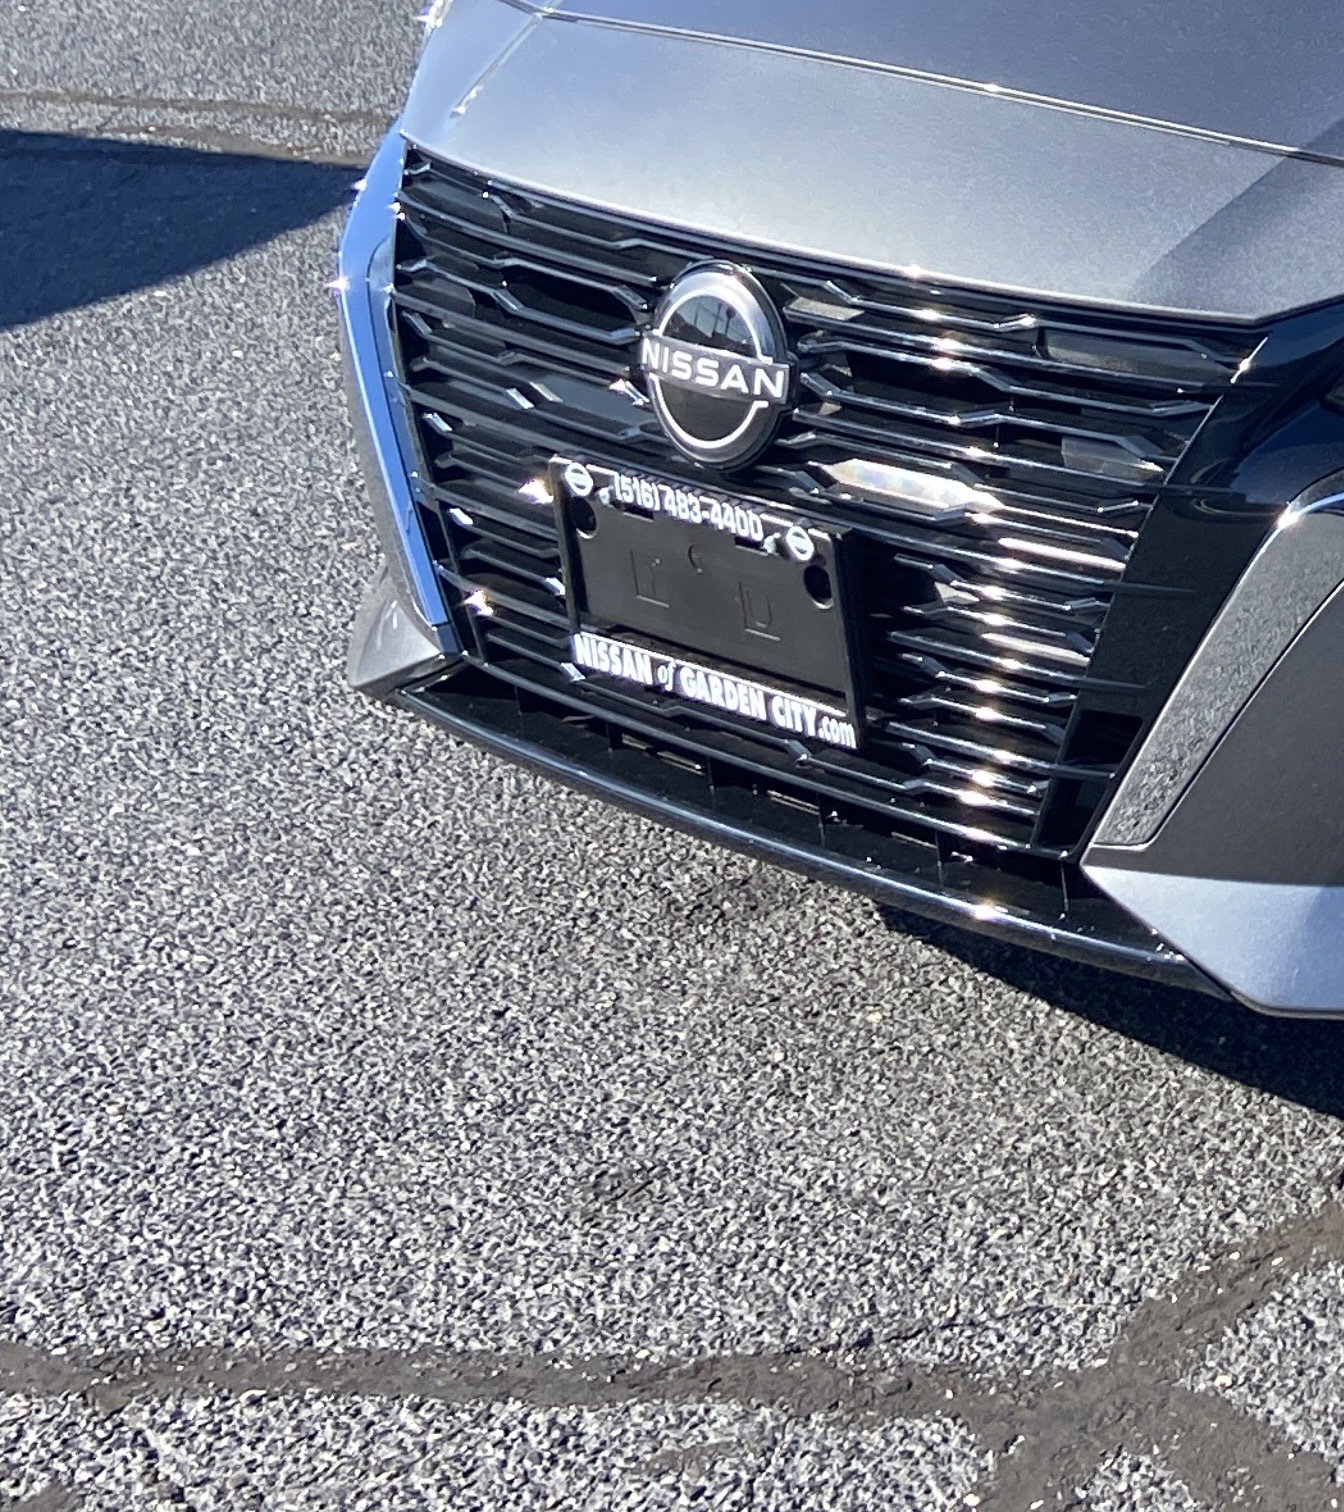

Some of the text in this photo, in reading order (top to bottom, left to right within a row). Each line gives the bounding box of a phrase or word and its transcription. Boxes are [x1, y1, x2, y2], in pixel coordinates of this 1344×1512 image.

[641, 337, 785, 398] NISSAN
[573, 633, 858, 750] NISSAN of GARDEN CITY.com
